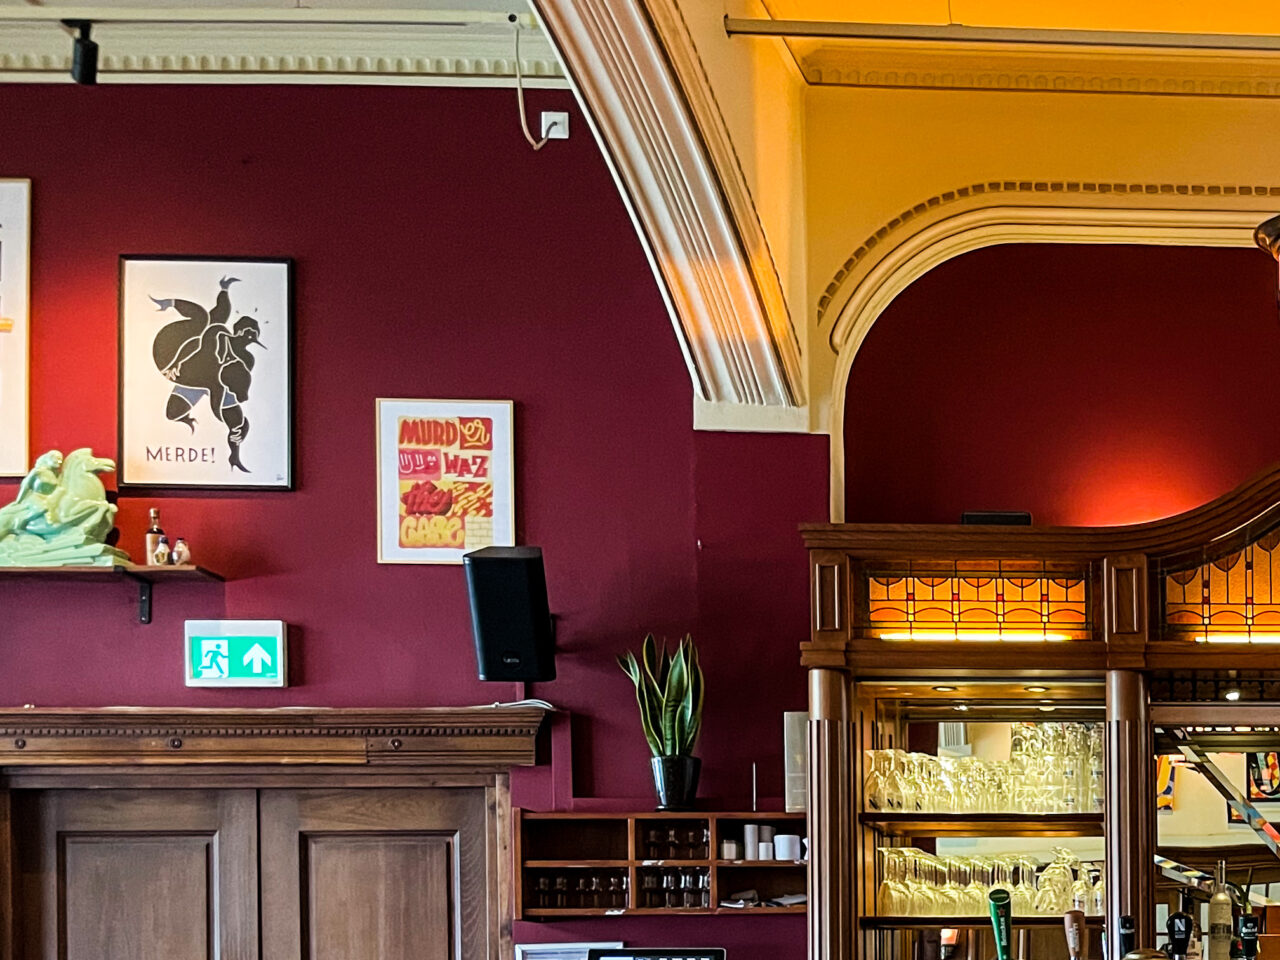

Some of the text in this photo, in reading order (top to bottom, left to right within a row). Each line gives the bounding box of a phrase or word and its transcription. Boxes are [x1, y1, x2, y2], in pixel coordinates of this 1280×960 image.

[146, 446, 215, 463] MERDE!
[443, 452, 489, 478] WAZ
[1174, 918, 1186, 932] N
